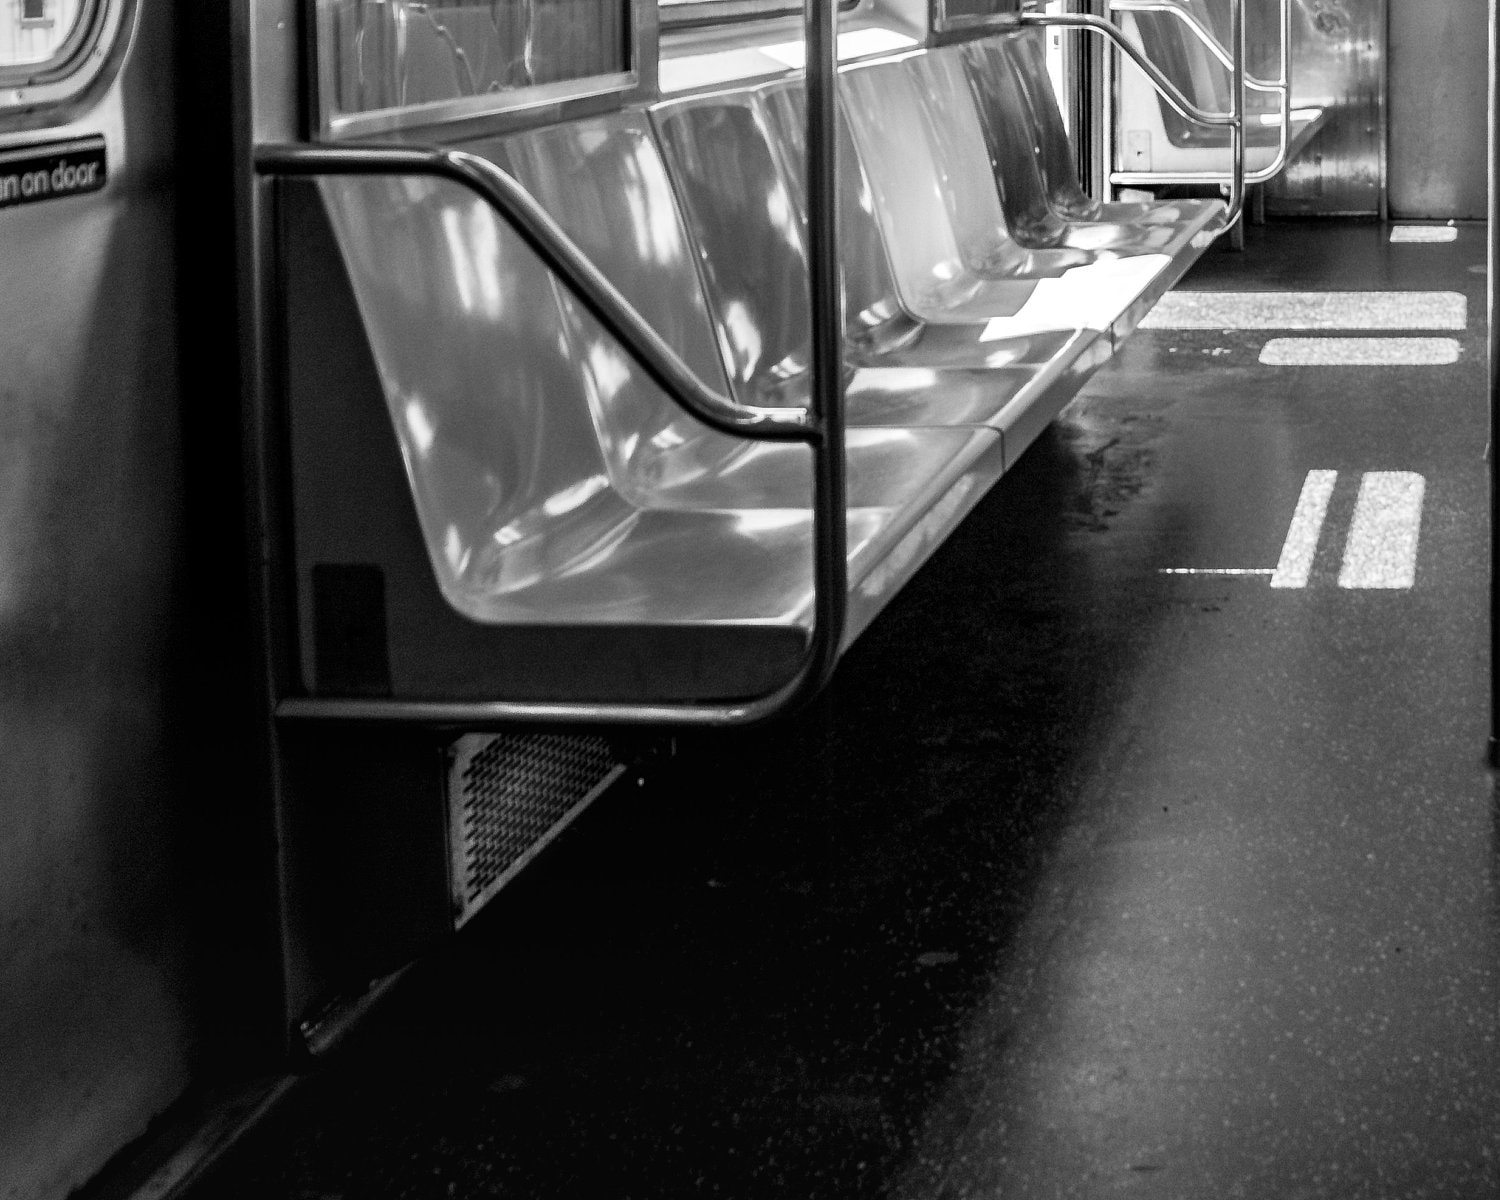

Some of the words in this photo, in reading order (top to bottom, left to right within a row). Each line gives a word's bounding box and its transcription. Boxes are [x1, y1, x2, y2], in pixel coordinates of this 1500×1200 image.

[0, 173, 20, 200] n
[21, 169, 51, 197] on
[51, 159, 99, 192] door
